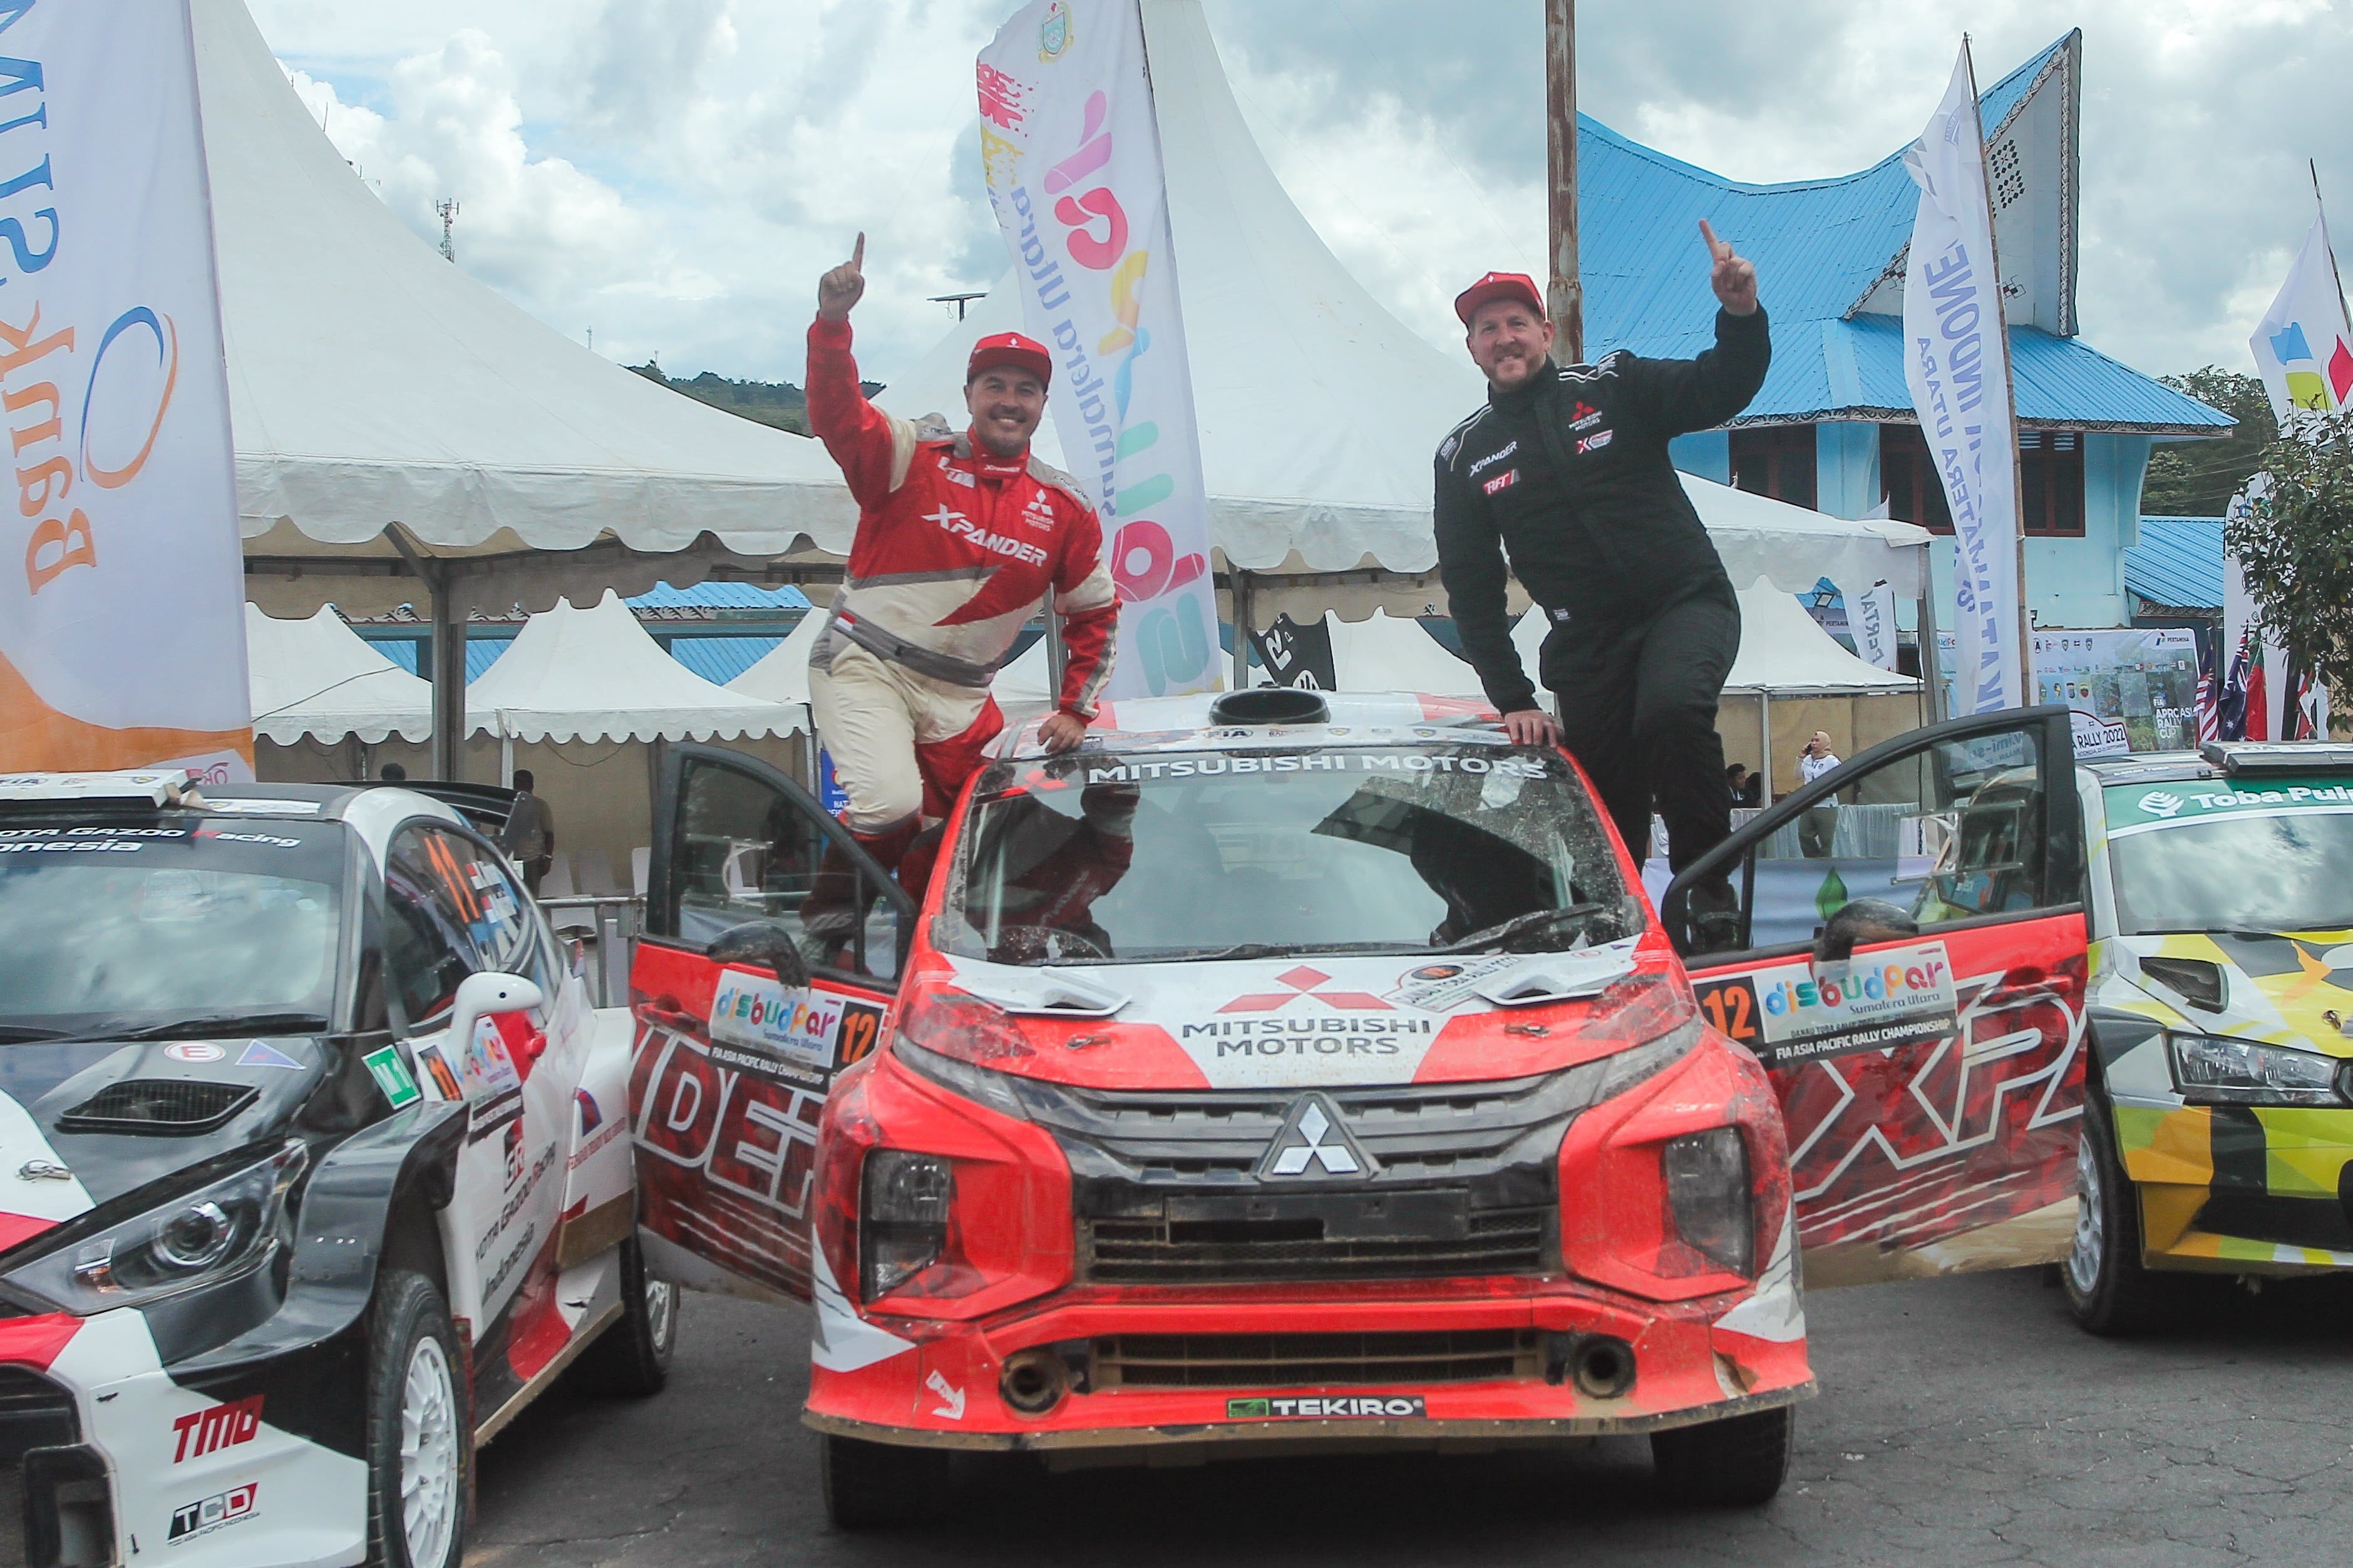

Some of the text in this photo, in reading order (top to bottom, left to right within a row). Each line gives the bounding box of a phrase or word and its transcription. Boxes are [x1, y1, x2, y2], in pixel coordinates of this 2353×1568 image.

[1575, 418, 1601, 431] MOTORS
[1470, 441, 1518, 477] XPANDER
[922, 503, 1048, 567] XPANDER
[2156, 707, 2179, 719] APRC
[2157, 719, 2183, 729] RALLY
[2078, 732, 2103, 749] RALLY
[2103, 727, 2126, 744] 2022
[2160, 729, 2177, 739] CUP
[1088, 754, 1548, 784] MITSUBISHI MOTORS
[2189, 785, 2353, 809] Toba Pul
[66, 827, 187, 838] GAZOO
[192, 829, 301, 848] Racing
[1765, 961, 1944, 1017] disbudpar
[716, 987, 836, 1038] disbudpar
[1702, 985, 1756, 1040] 12
[1850, 997, 1905, 1015] Sumatera
[1907, 992, 1940, 1009] Utara
[841, 1012, 876, 1063] 12
[1182, 1018, 1431, 1038] MITSUBISHI
[1776, 1017, 1952, 1060] FIA ASIA PACIFIC RALLY CHAMPIONSHIP
[1216, 1037, 1400, 1057] MOTORS
[175, 1487, 252, 1532] TCD
